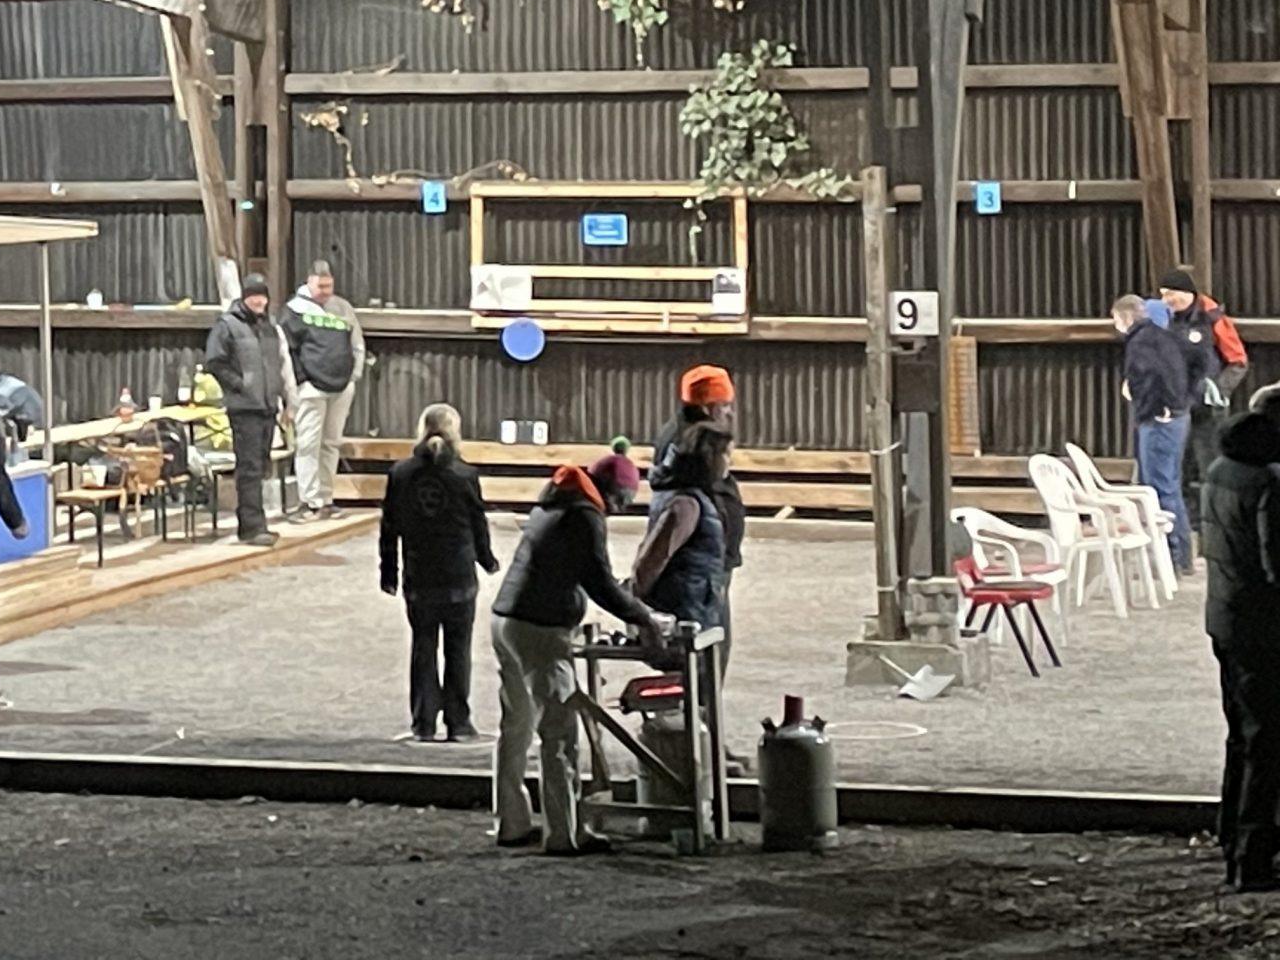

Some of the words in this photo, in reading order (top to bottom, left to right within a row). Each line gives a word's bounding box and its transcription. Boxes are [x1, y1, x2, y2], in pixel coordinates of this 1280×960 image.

[429, 193, 440, 206] 4
[983, 191, 995, 208] 3
[897, 298, 918, 330] 9
